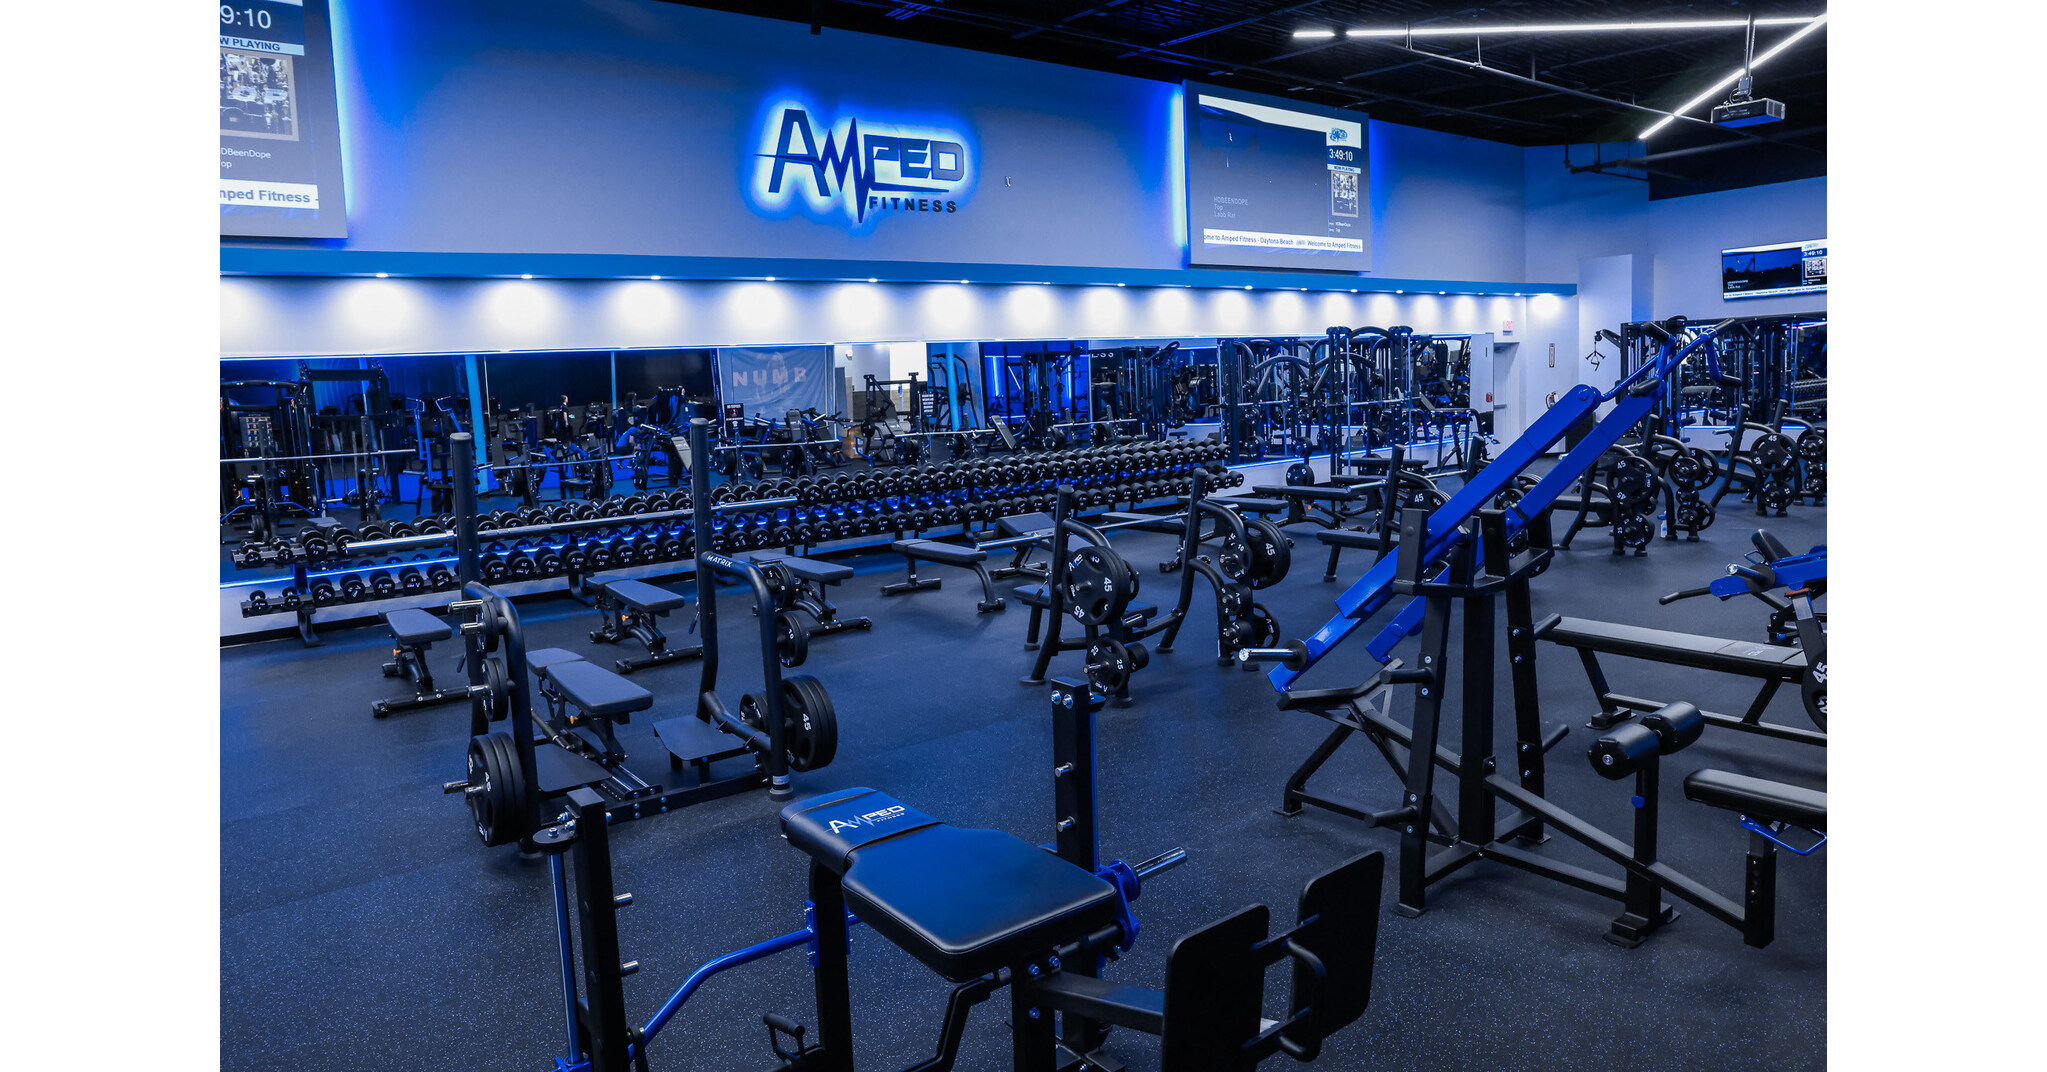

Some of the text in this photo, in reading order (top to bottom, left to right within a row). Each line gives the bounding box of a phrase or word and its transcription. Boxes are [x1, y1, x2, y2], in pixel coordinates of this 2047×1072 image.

[220, 5, 271, 29] 9:10
[232, 38, 280, 51] PLAYING
[1329, 148, 1353, 162] 3:49:10
[754, 109, 965, 223] AMPED
[259, 190, 311, 203] Fitness
[868, 196, 957, 213] FITNESS
[1222, 234, 1239, 243] Amped
[1260, 237, 1279, 245] Daytona
[732, 367, 807, 387] NUMB
[1616, 460, 1626, 469] 45
[1414, 493, 1424, 503] 45
[1265, 542, 1276, 556] 45
[707, 555, 733, 568] MATRIX
[1103, 577, 1113, 592] 45
[1073, 605, 1085, 619] 45
[1090, 645, 1099, 656] 25
[1116, 659, 1124, 670] 25
[1812, 661, 1827, 684] 45
[802, 713, 811, 731] 45
[824, 805, 905, 834] AMPED
